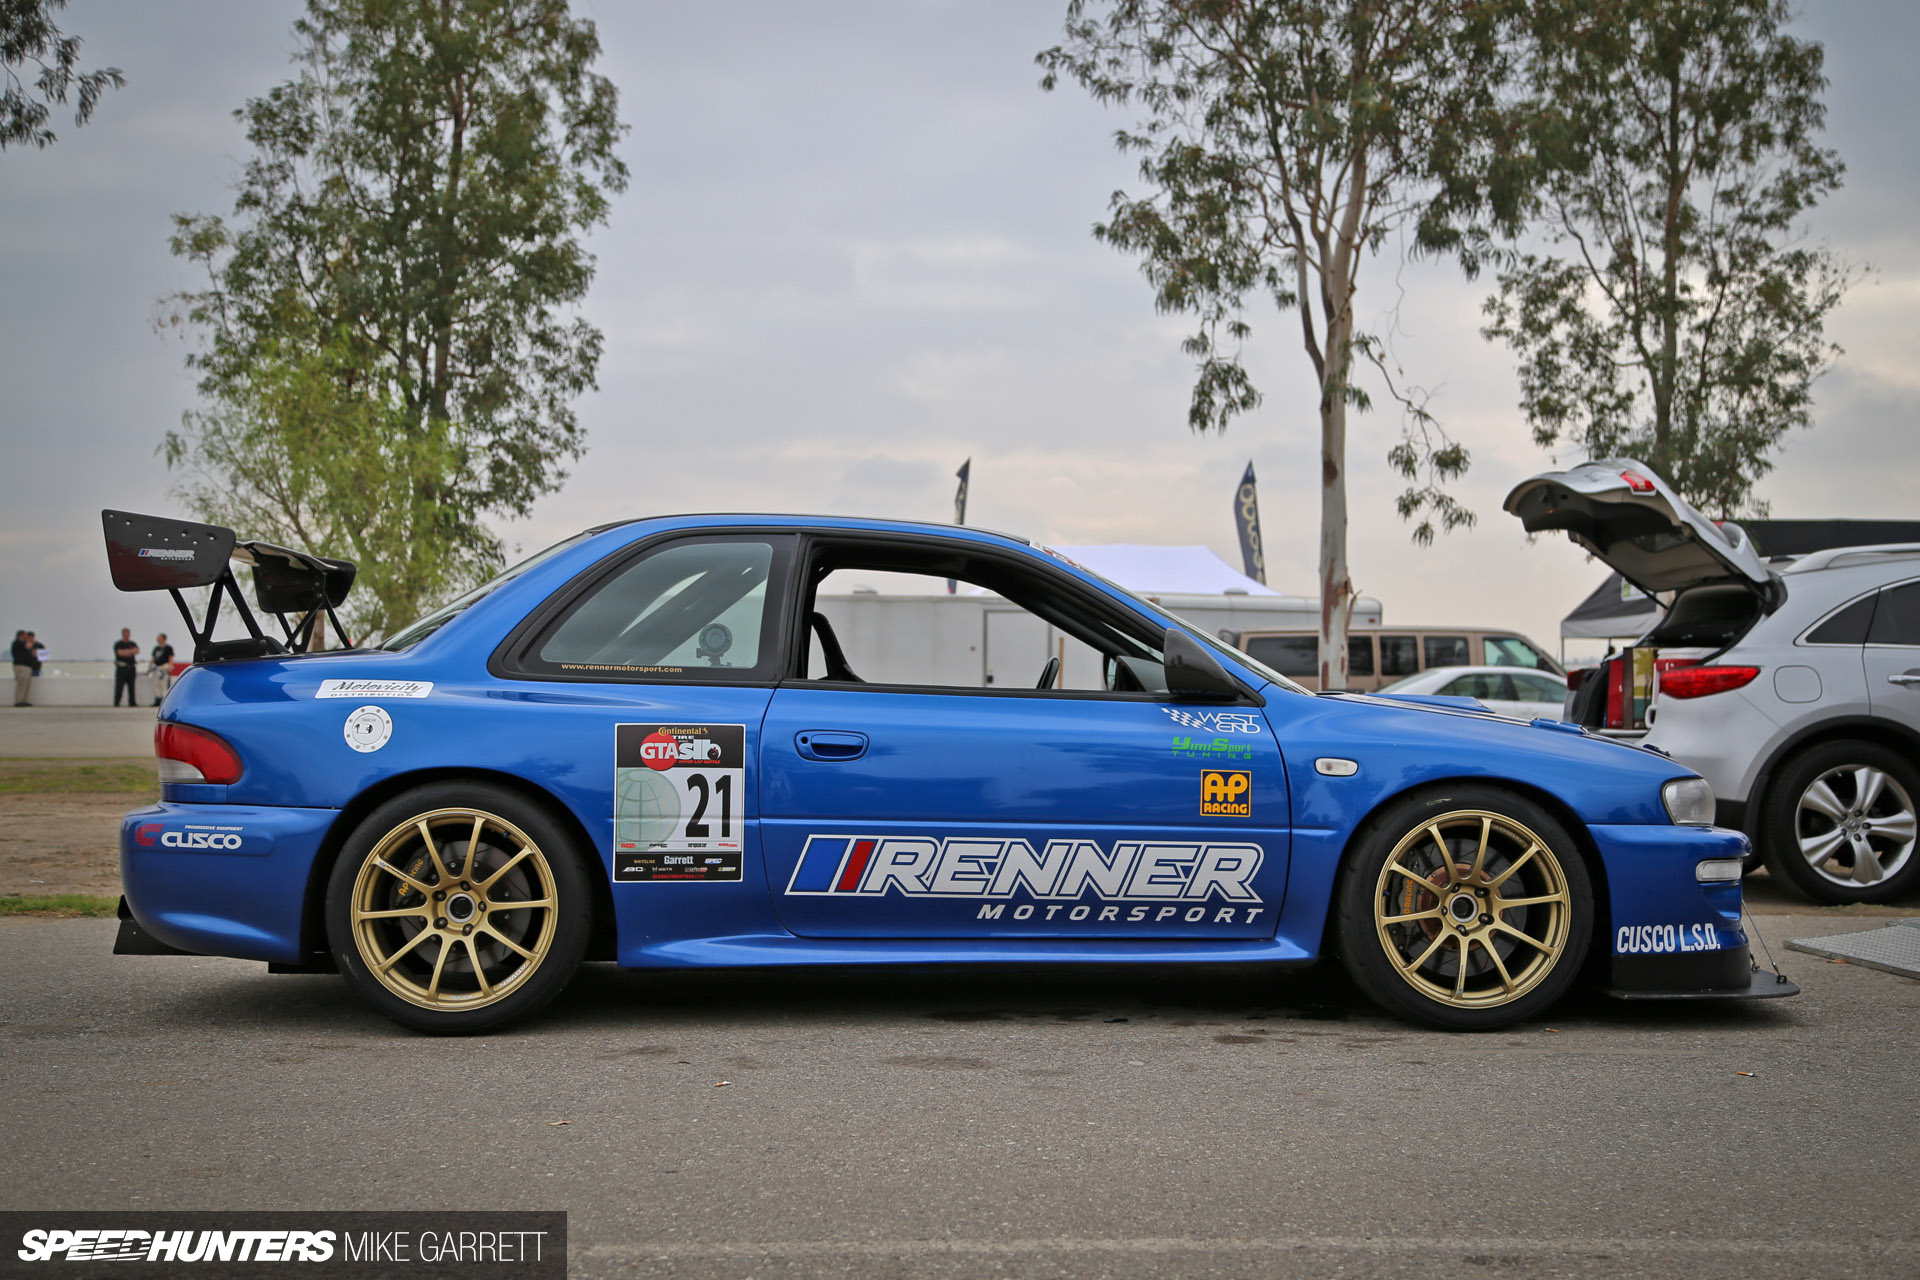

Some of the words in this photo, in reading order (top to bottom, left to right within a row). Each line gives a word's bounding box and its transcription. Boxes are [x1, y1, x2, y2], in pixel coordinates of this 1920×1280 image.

[561, 663, 683, 673] www.rennermotorsport.com
[332, 681, 423, 694] Motovicity
[1198, 711, 1259, 725] WEST
[658, 726, 702, 736] Continental
[1216, 722, 1261, 734] END
[1171, 751, 1252, 759] TUNING
[1204, 773, 1248, 802] AP
[685, 773, 731, 838] 21
[1204, 803, 1248, 814] RACING
[161, 832, 242, 849] CUSCO
[664, 855, 694, 865] Garrett
[858, 838, 1265, 903] RENNER
[398, 882, 409, 896] AP
[976, 903, 1265, 924] MOTORSPORT
[1616, 924, 1676, 953] CUSCO
[1679, 922, 1721, 952] L.S.D.
